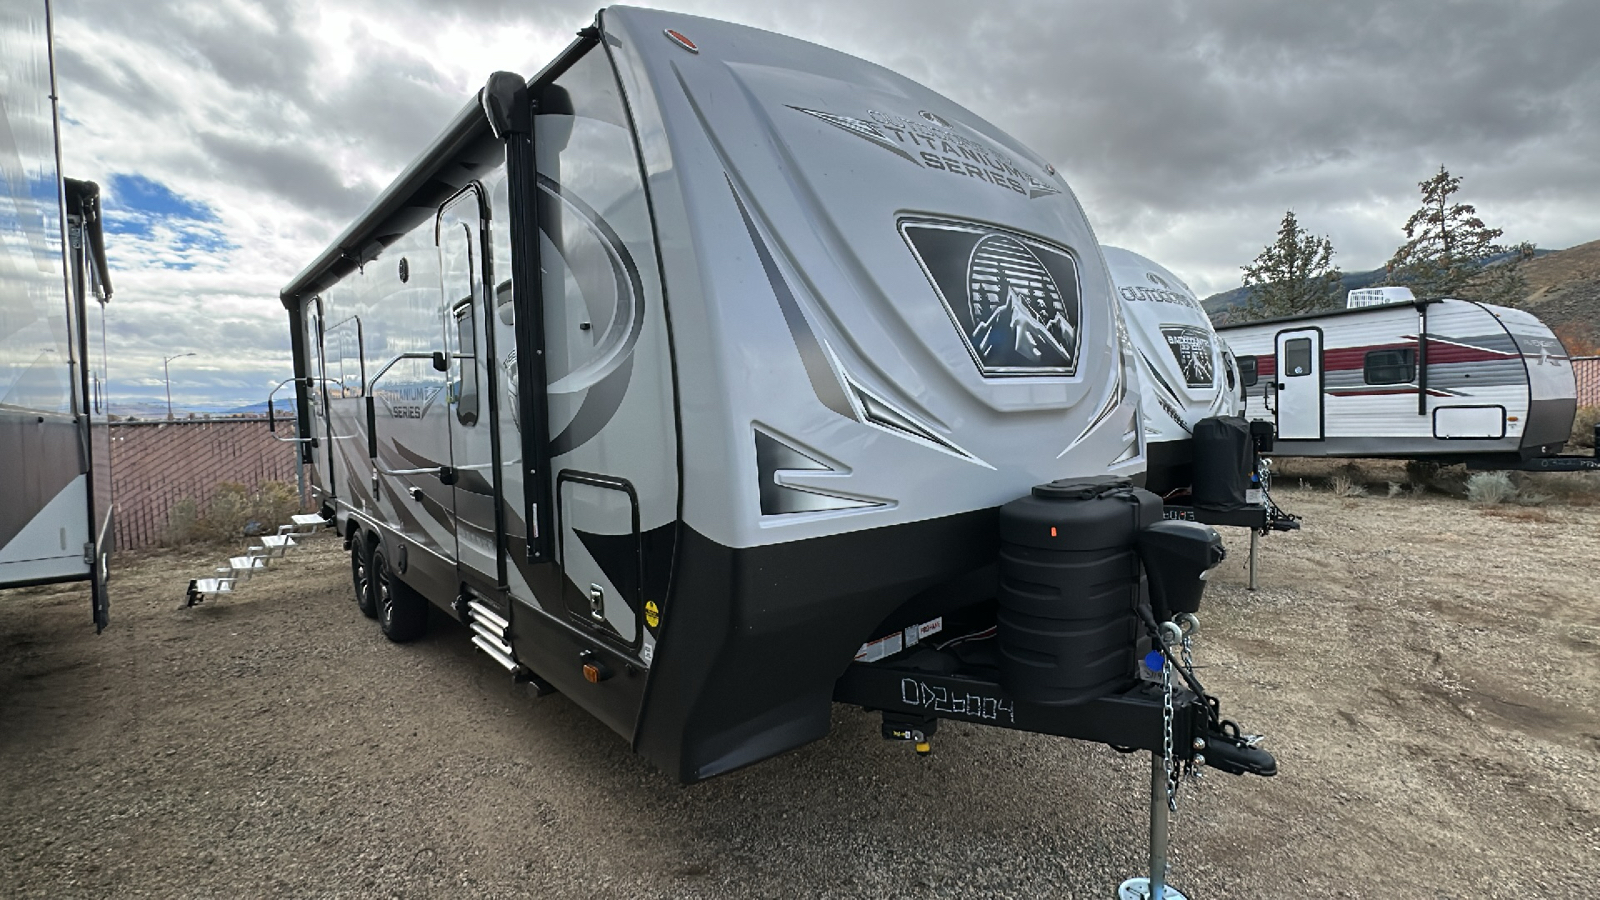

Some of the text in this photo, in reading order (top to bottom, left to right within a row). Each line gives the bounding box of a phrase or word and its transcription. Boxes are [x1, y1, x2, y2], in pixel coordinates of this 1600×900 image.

[883, 124, 1026, 181] TITANIUM
[920, 151, 1027, 195] SERIES
[393, 406, 420, 418] SERIES
[901, 677, 1015, 723] OD26004
